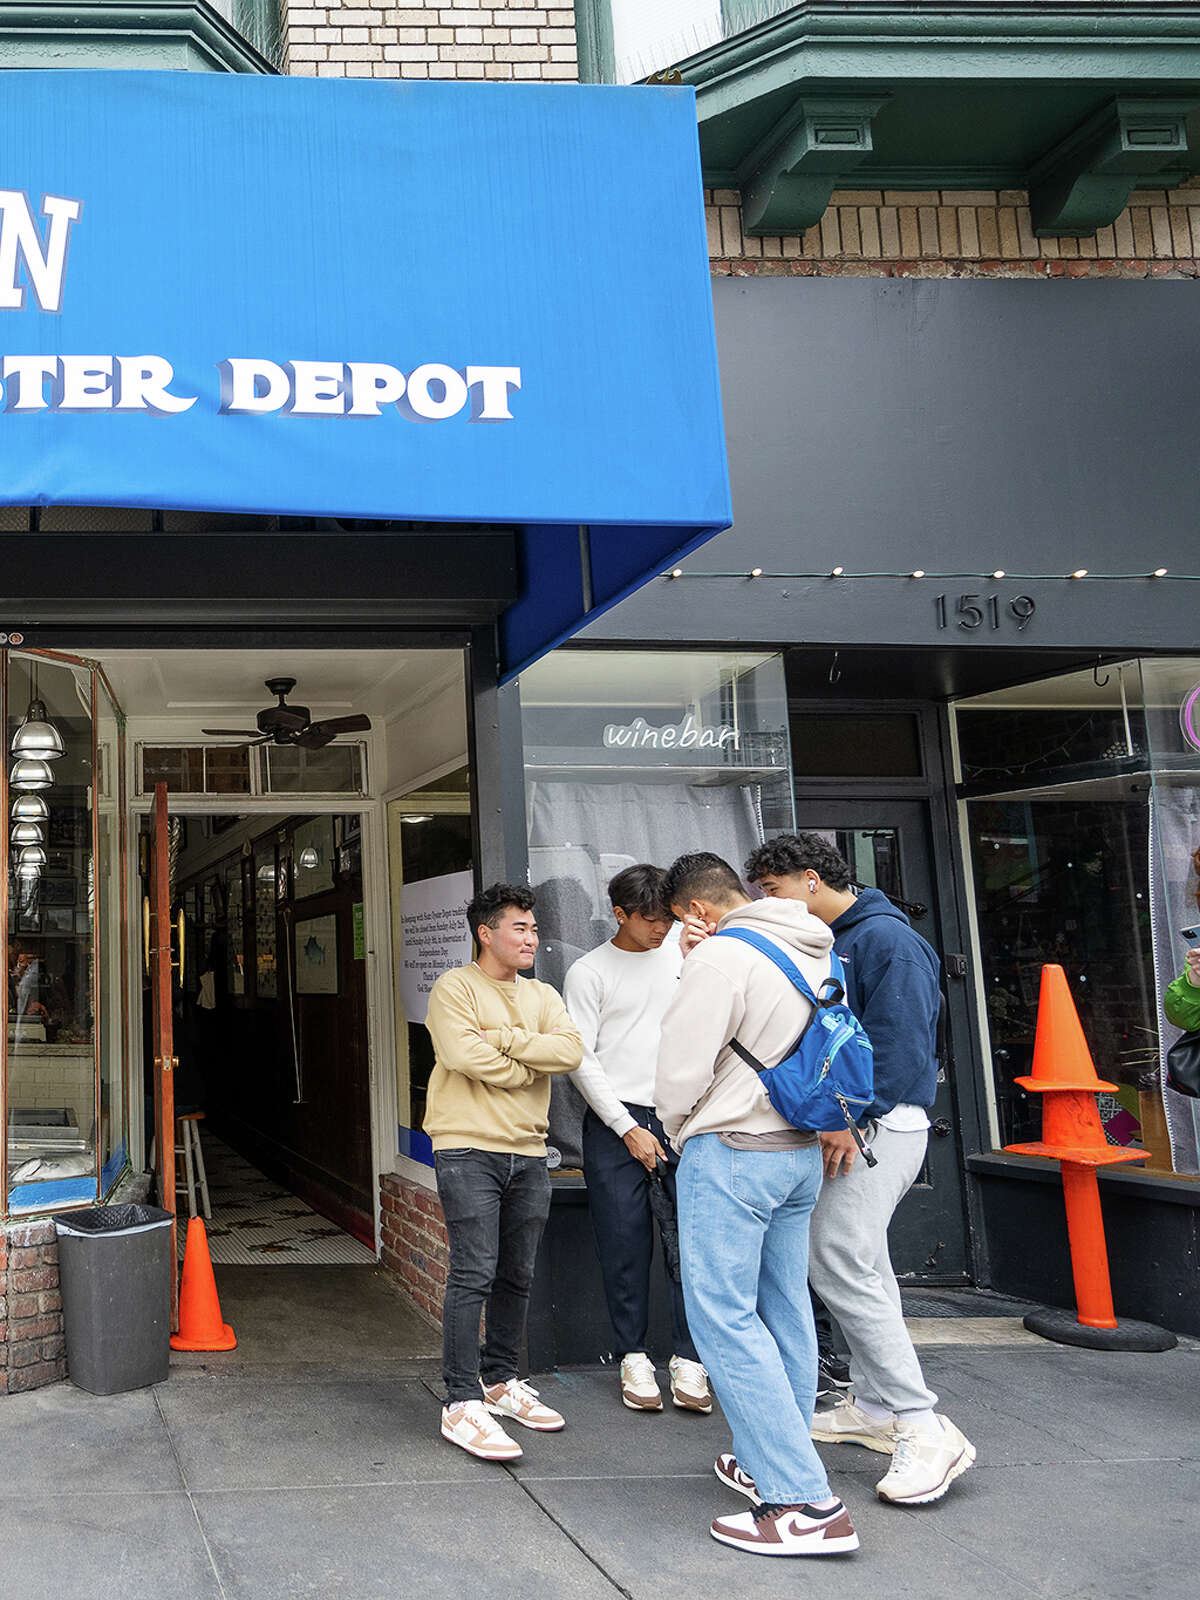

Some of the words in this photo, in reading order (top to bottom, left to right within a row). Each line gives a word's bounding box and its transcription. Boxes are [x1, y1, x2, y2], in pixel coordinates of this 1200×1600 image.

[220, 357, 522, 422] DEPOT
[936, 594, 1036, 631] 1519
[607, 716, 739, 748] winebar
